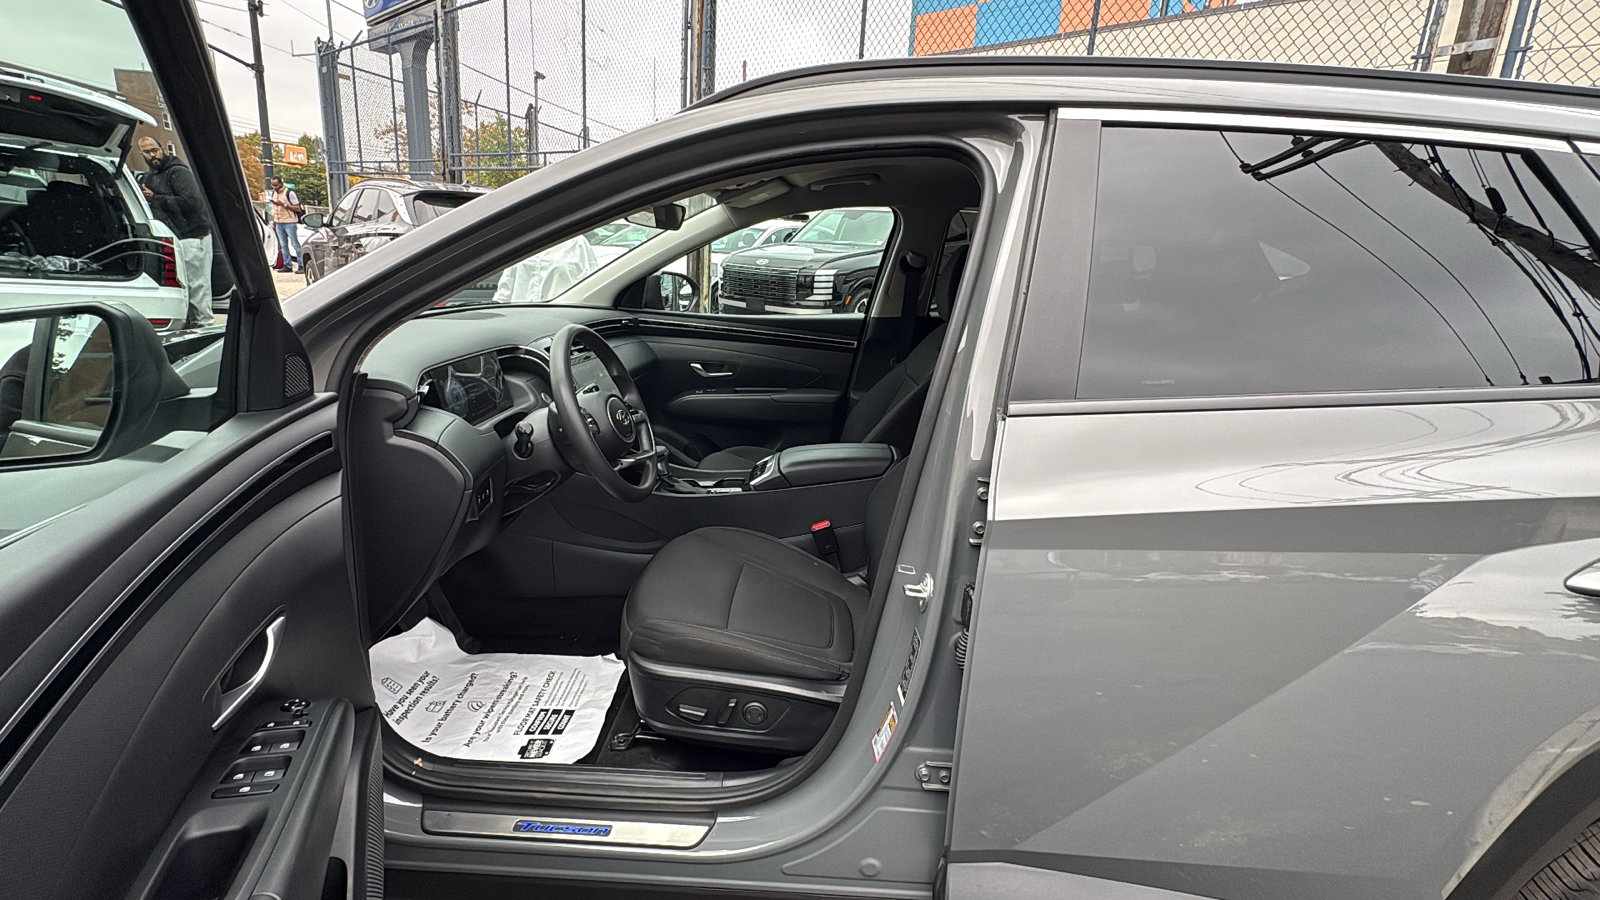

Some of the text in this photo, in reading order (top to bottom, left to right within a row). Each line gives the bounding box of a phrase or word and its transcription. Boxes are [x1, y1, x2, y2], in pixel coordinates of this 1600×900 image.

[382, 670, 431, 719] Have you seen your
[392, 675, 440, 726] inspection results?
[428, 721, 444, 737] your
[437, 699, 462, 721] battery
[456, 672, 479, 699] charged?
[463, 671, 518, 748] Are your wipers streaking?
[512, 717, 529, 735] FLOOR
[524, 706, 537, 719] MAT
[531, 688, 548, 707] SAFETY
[542, 670, 557, 688] CHECK
